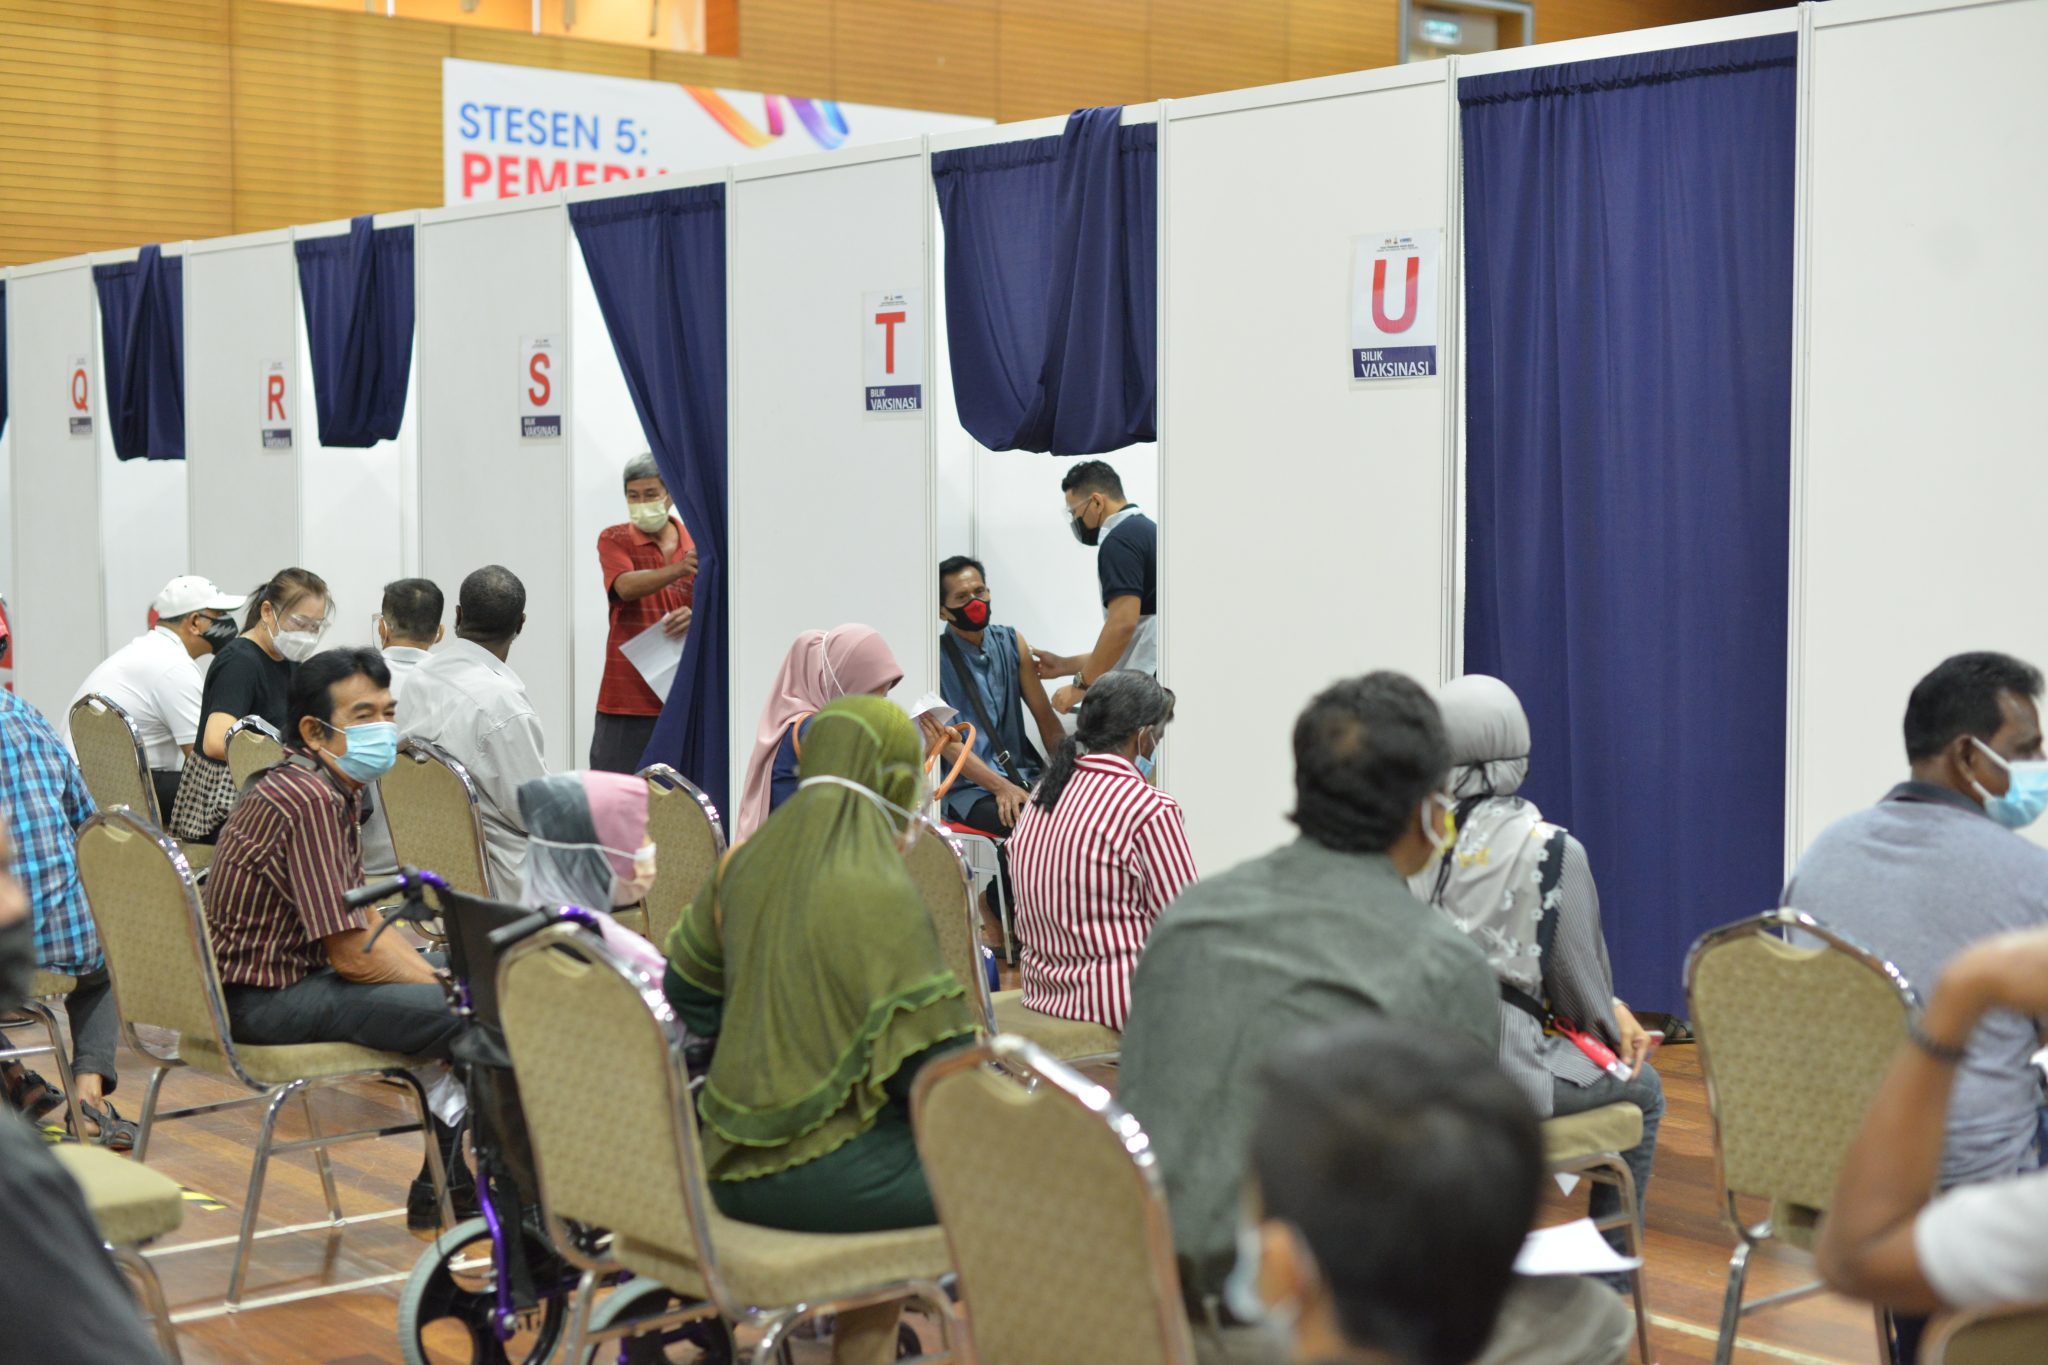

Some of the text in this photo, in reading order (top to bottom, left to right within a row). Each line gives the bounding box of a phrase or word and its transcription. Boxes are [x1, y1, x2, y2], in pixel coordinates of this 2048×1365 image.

[460, 102, 647, 155] STESEN 5:
[1372, 256, 1419, 334] U
[875, 311, 906, 374] T
[1361, 351, 1383, 361] BILIK
[72, 368, 88, 413] Q
[528, 352, 551, 407] S
[1361, 361, 1429, 377] VAKSINASI
[268, 374, 286, 421] R
[870, 397, 917, 410] VAKSINASI
